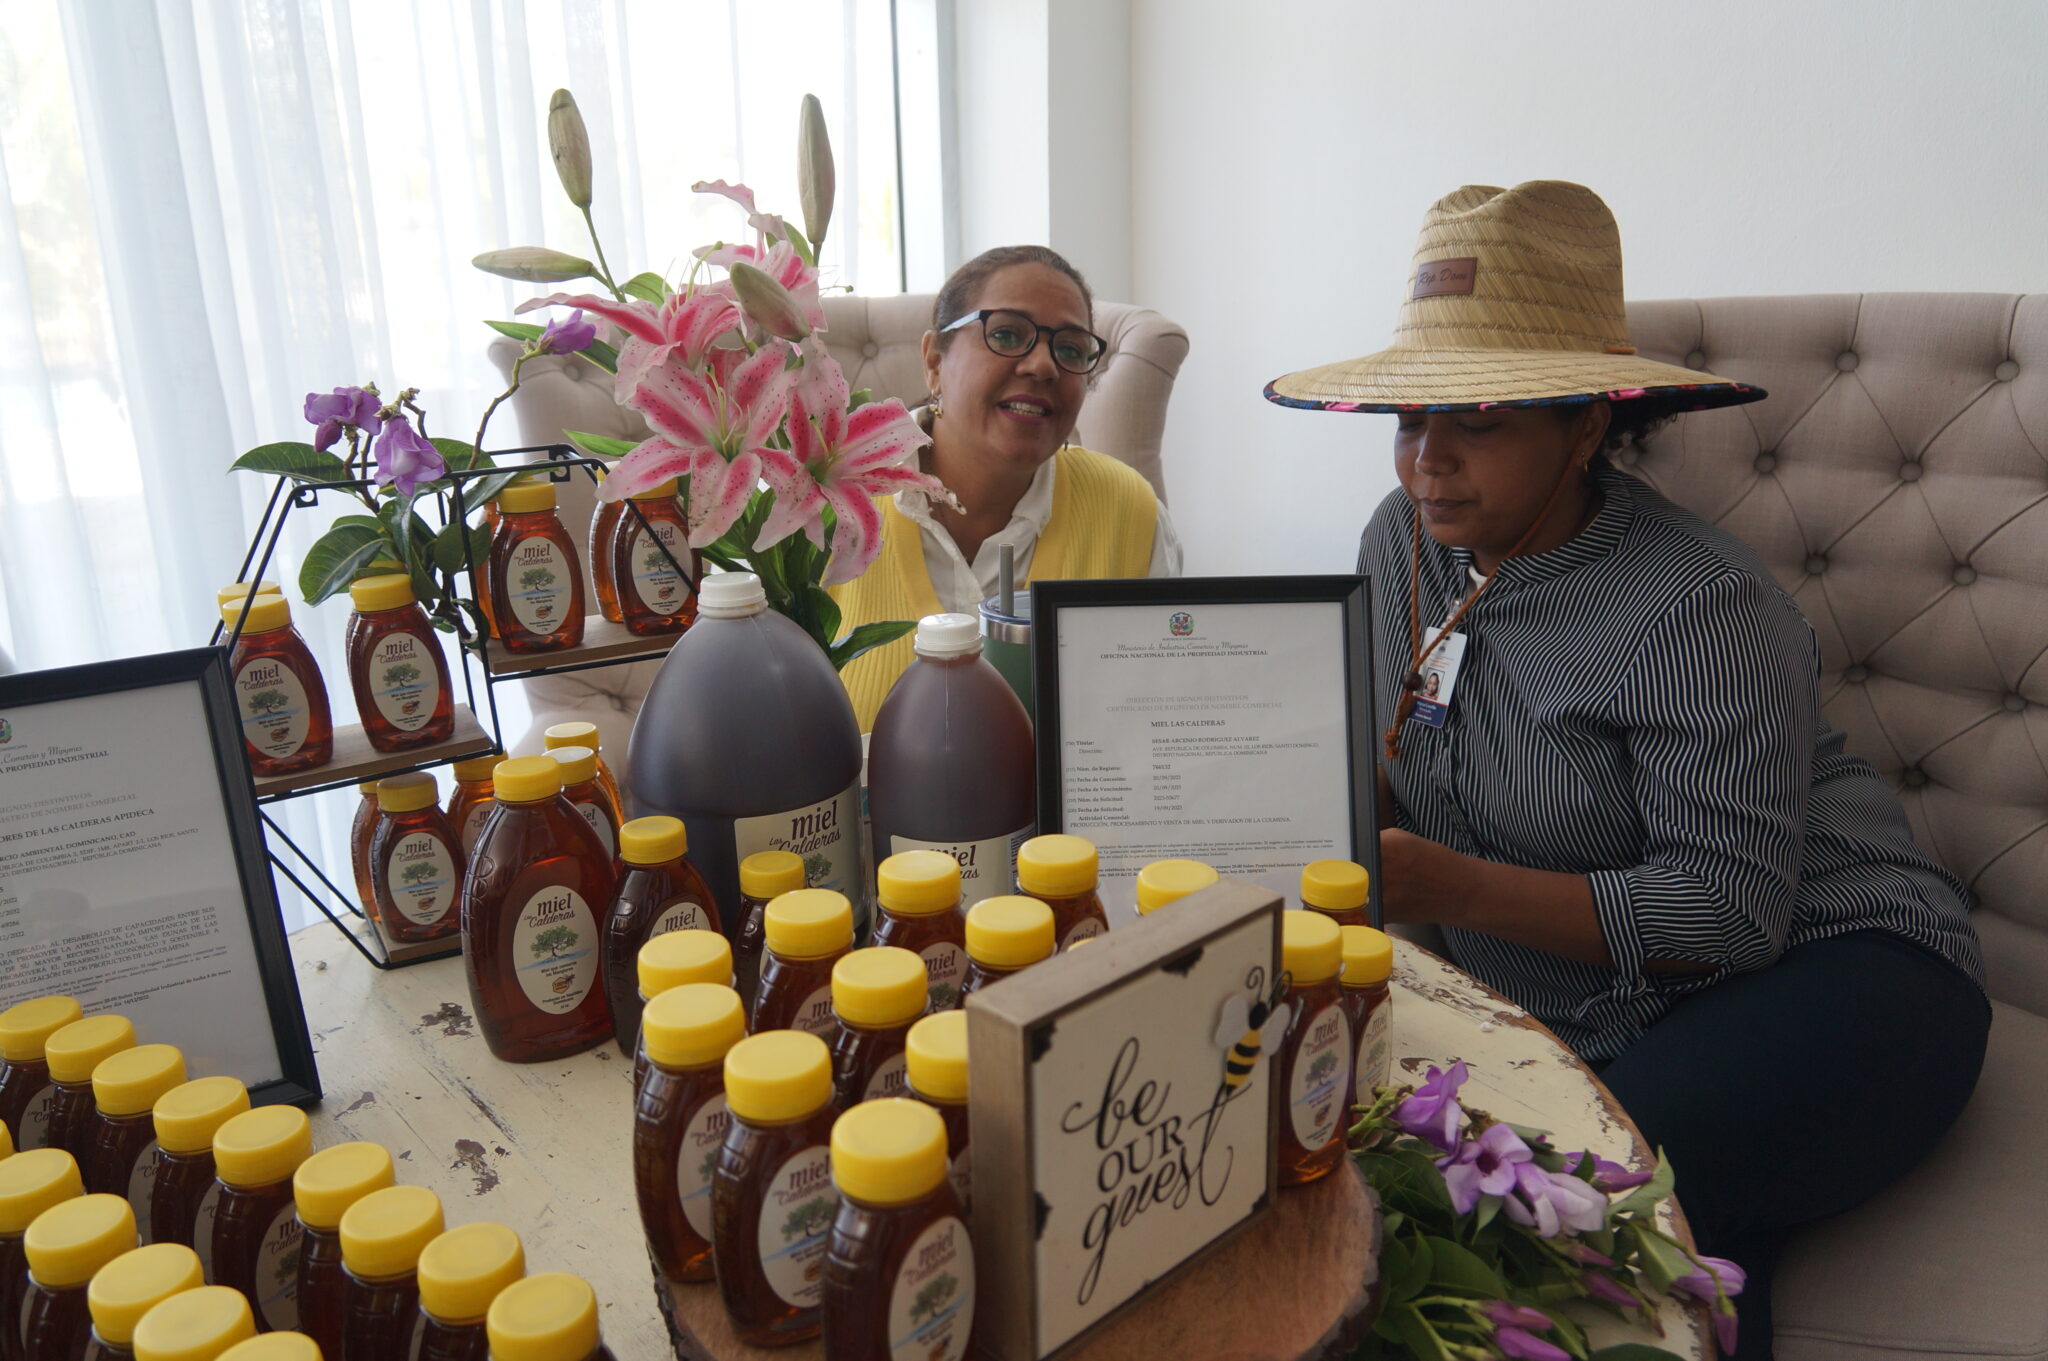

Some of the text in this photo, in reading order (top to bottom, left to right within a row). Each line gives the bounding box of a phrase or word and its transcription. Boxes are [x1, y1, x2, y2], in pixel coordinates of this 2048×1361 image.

[649, 527, 674, 540] iel
[524, 544, 551, 558] miel
[385, 638, 414, 655] miel
[1187, 650, 1227, 658] PROPIEDAD
[1227, 649, 1269, 657] INDUSTRIAL
[249, 663, 280, 682] miel
[1151, 719, 1226, 728] MIEL LAS CALDERAS
[5, 750, 109, 774] PROPIEDAD INDUSTRIAL
[25, 829, 39, 839] DE
[40, 825, 60, 836] LAS
[61, 816, 112, 832] CALDERAS
[113, 807, 155, 823] APIDECA
[791, 799, 838, 841] miel
[20, 831, 136, 859] AMBIENTAL DOMINICANO, CAD
[405, 838, 433, 854] miel
[769, 828, 842, 855] Las Calderas
[930, 844, 977, 867] iel
[537, 892, 572, 917] miel
[62, 929, 111, 945] DESARROLLO
[113, 926, 124, 934] DE
[125, 914, 176, 931] CAPACIDADES
[177, 908, 201, 920] ENTRE
[202, 905, 215, 914] SUS
[138, 919, 188, 936] IMPORTANCIA
[203, 913, 217, 921] LOS
[528, 910, 577, 929] Calderas
[665, 906, 697, 932] miel
[34, 955, 61, 967] MAYOR
[67, 947, 100, 960] RECURSO
[162, 927, 188, 938] DUNAS
[205, 920, 218, 929] LAS
[63, 953, 111, 968] DESARROLLO
[169, 929, 211, 943] SOSTENIBLE
[74, 965, 88, 974] LOS
[89, 955, 132, 971] PRODUCTOS
[154, 942, 190, 956] COLMENA
[1314, 1011, 1340, 1042] miel
[1061, 1037, 1171, 1150] be
[1098, 1116, 1184, 1193] OUR
[789, 1152, 830, 1190] miel
[1078, 1082, 1253, 1305] guest
